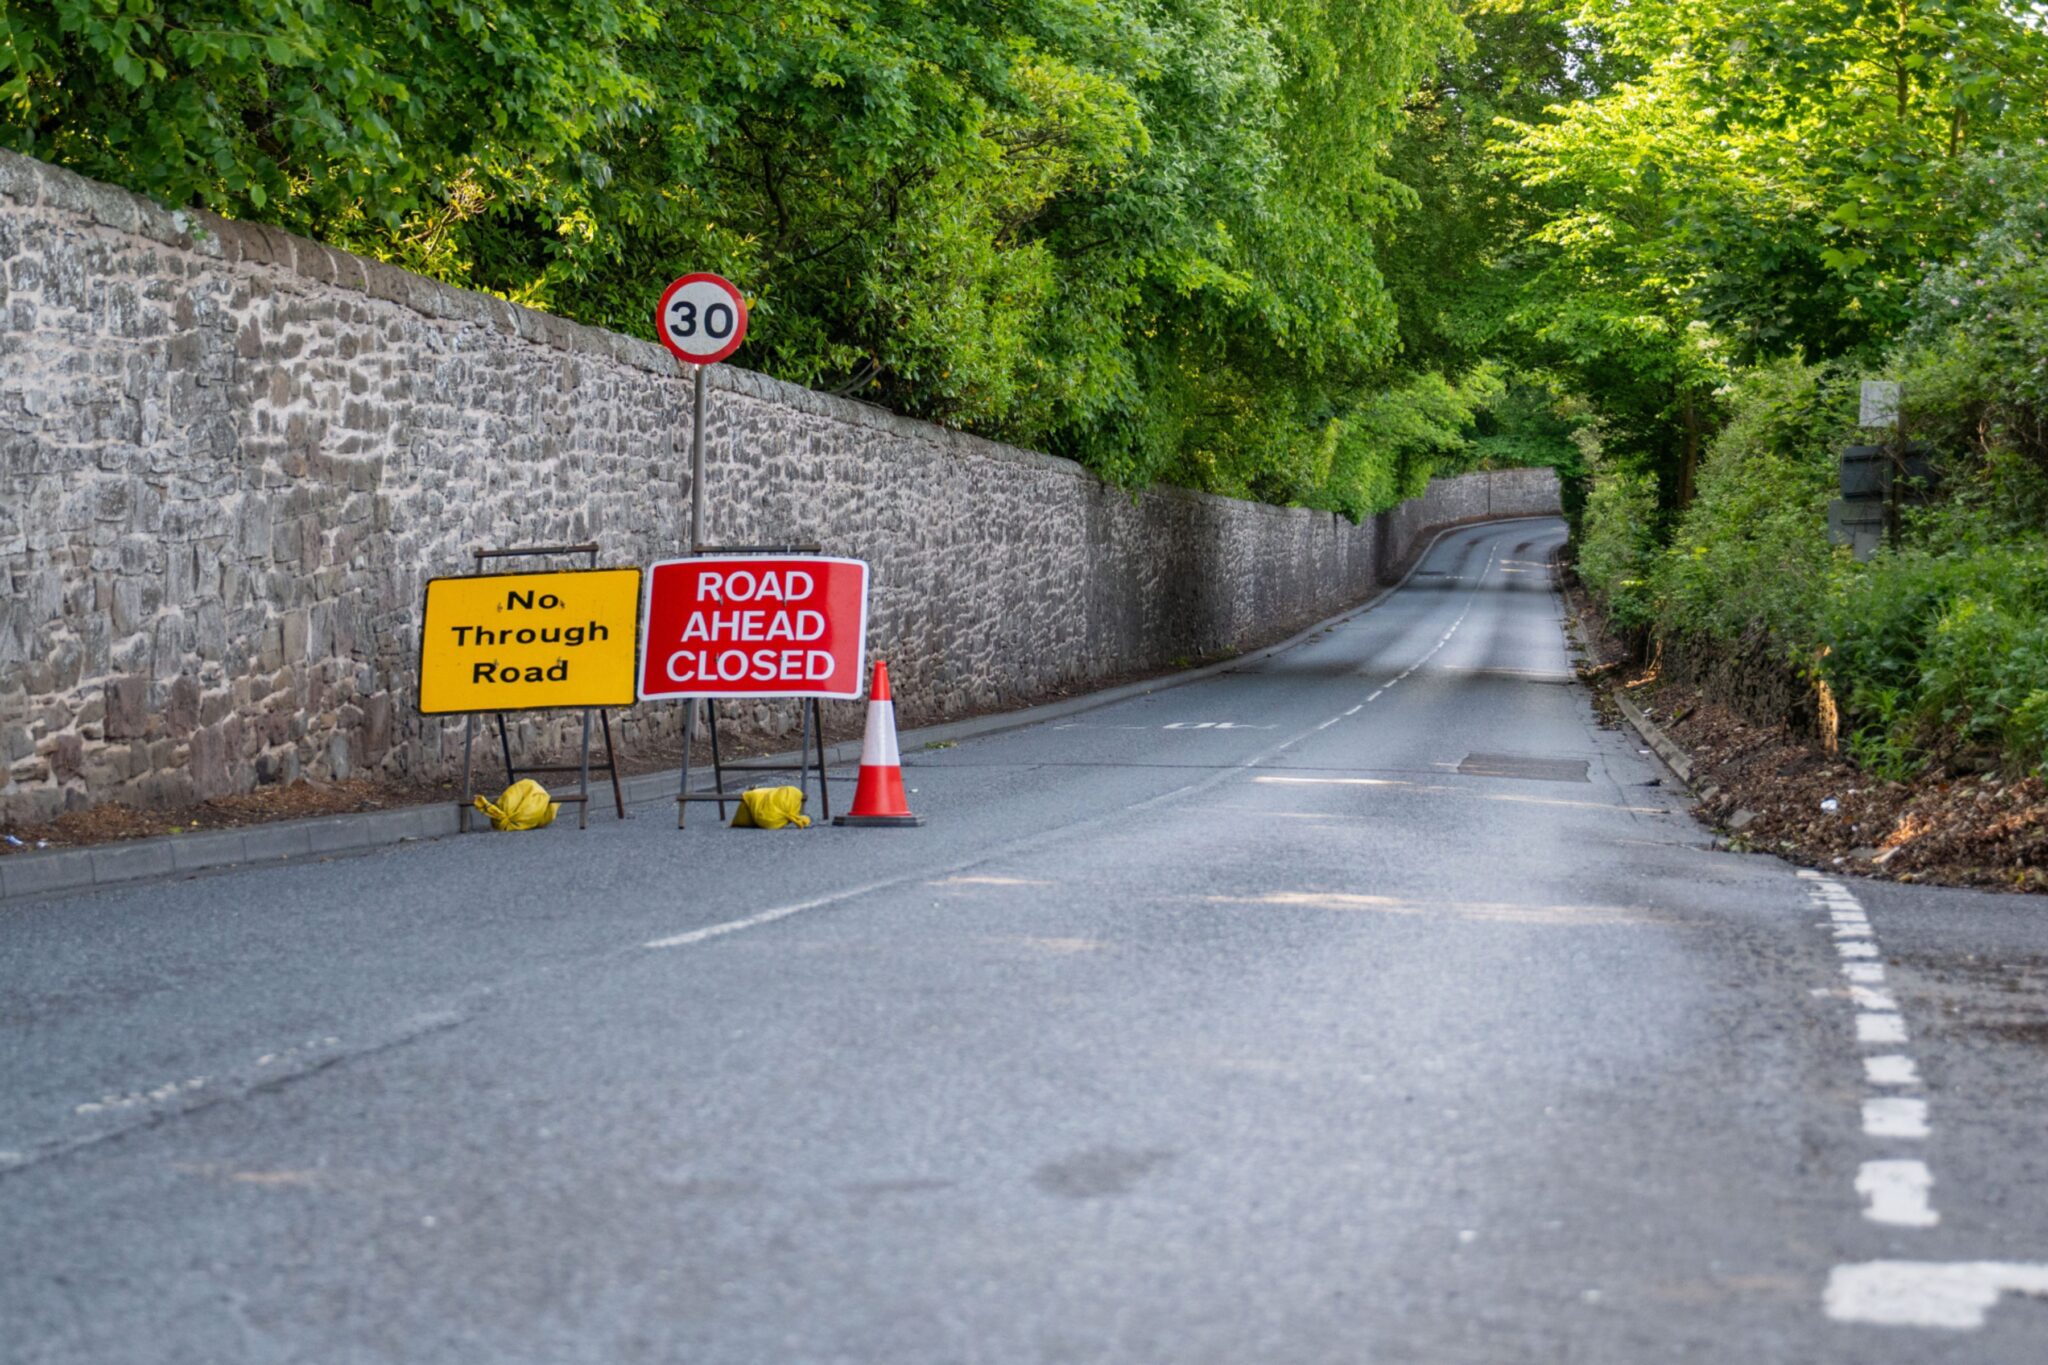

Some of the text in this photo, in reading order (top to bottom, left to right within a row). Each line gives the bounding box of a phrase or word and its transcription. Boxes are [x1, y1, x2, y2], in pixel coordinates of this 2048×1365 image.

[671, 301, 733, 338] 30
[506, 590, 560, 611] No
[697, 571, 814, 602] ROAD
[452, 621, 609, 647] Through
[681, 610, 825, 642] AHEAD
[472, 660, 568, 684] Road
[666, 649, 836, 682] CLOSED
